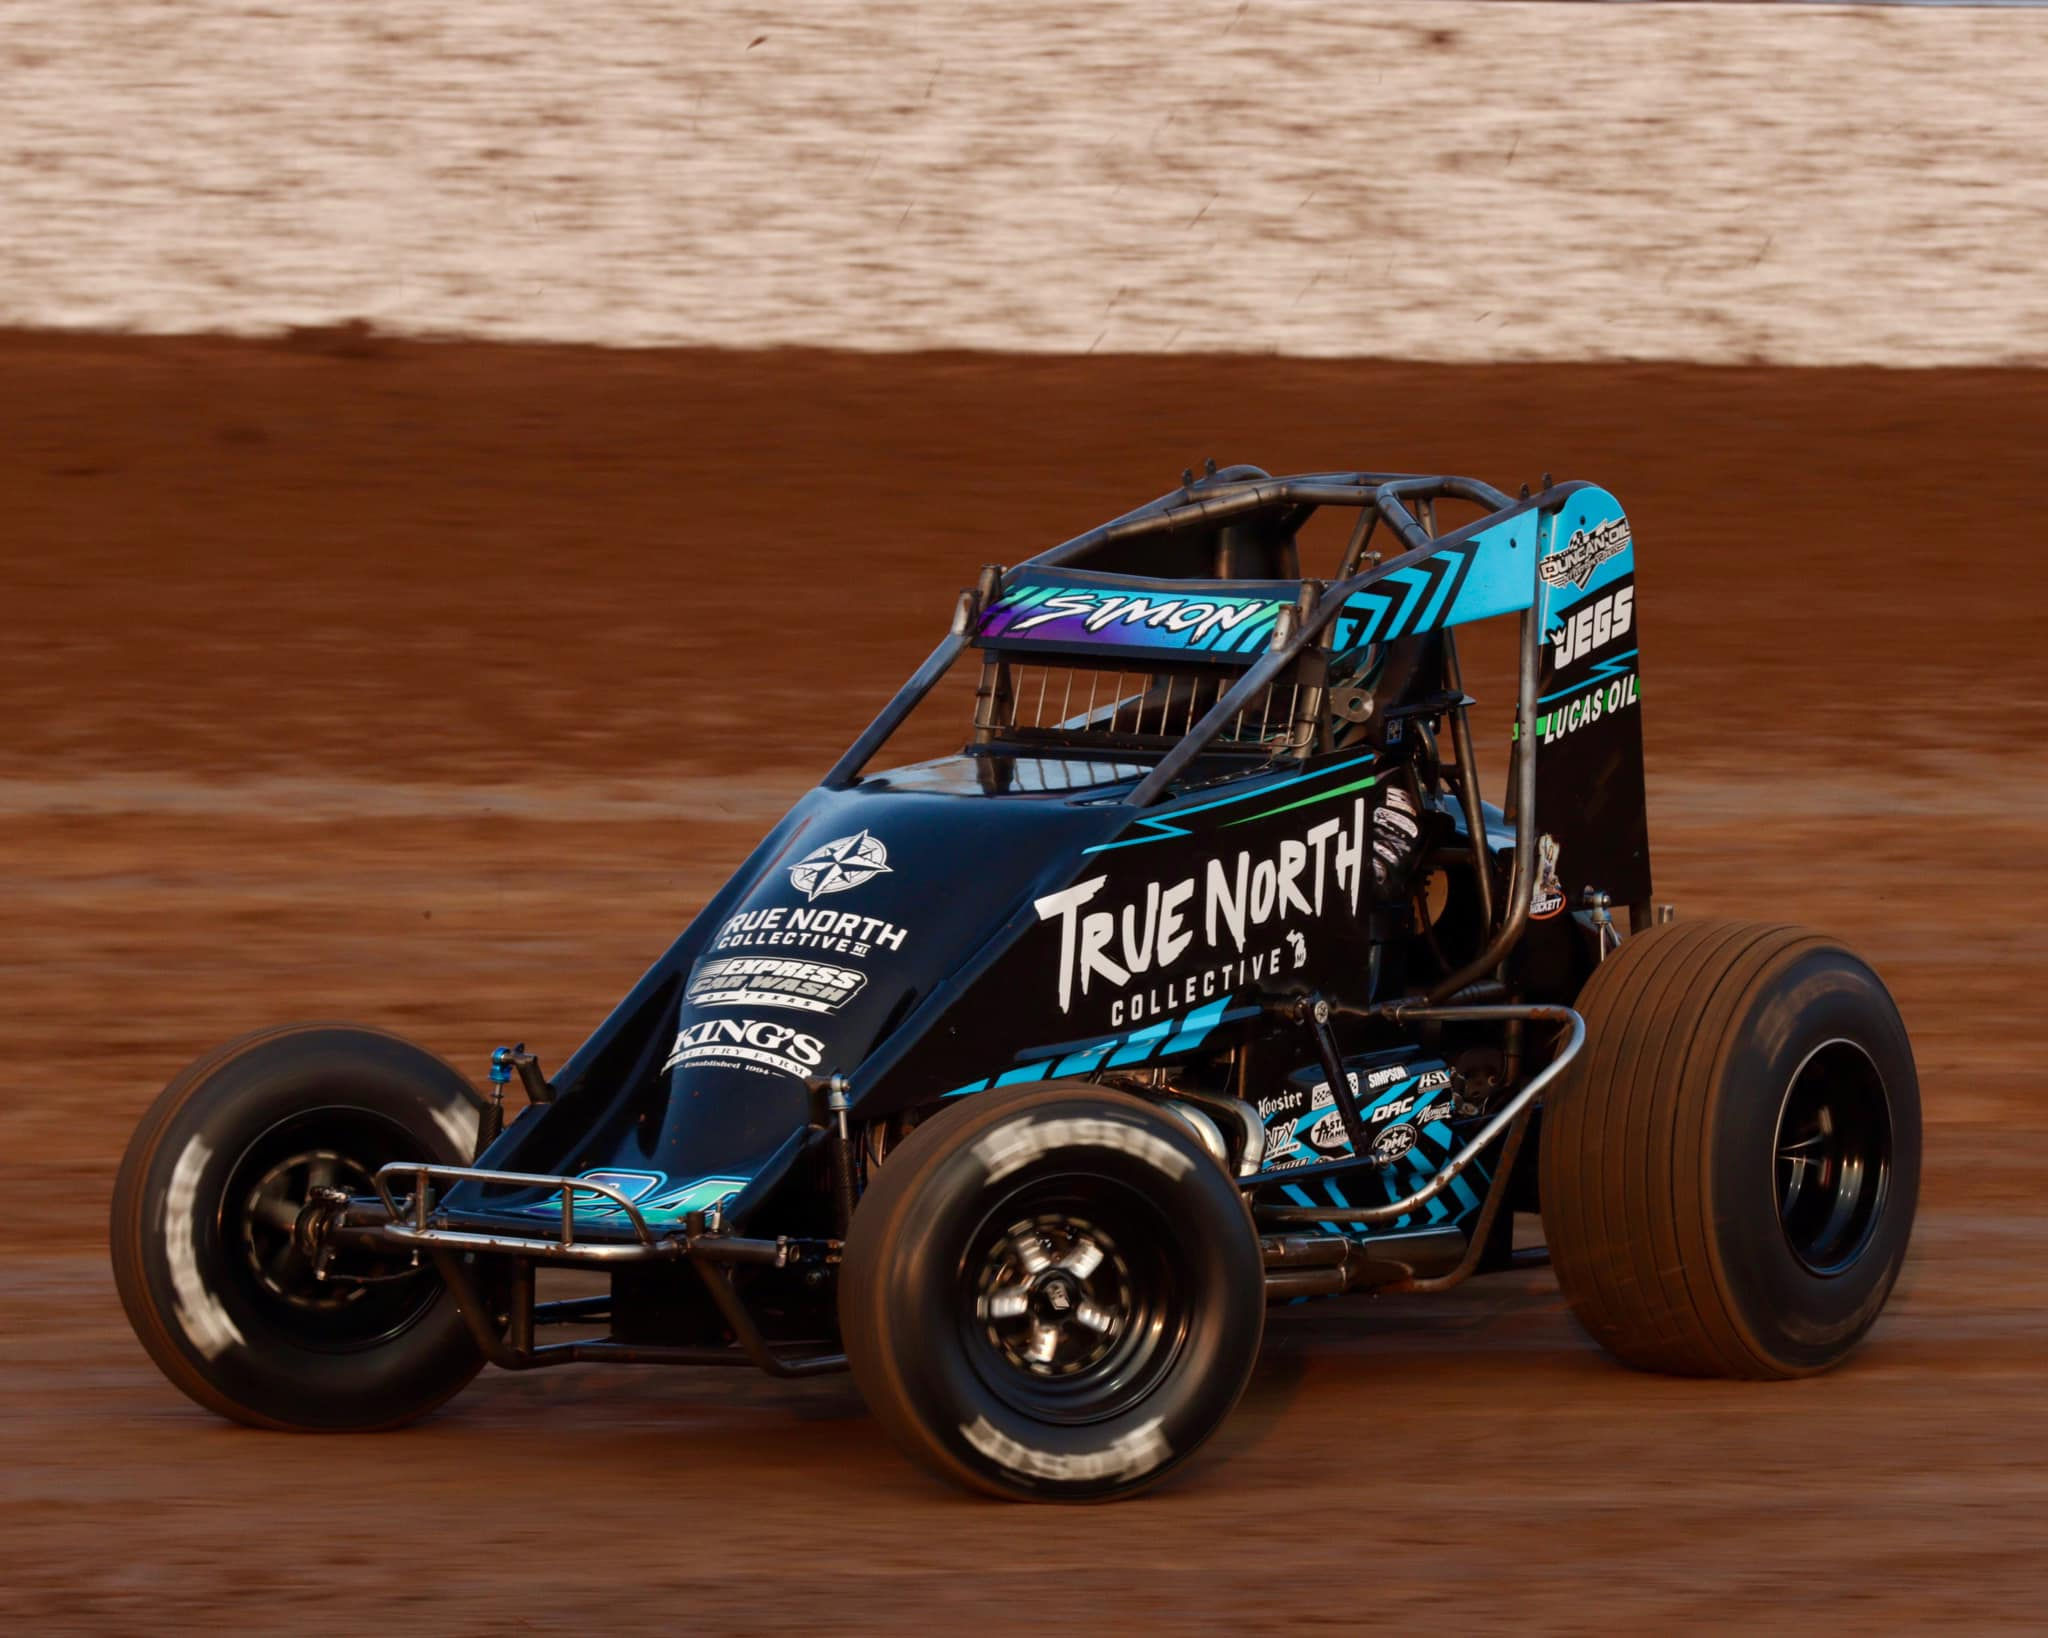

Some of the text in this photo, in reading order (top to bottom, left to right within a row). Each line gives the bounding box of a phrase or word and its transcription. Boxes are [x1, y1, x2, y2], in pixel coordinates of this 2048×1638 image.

[1540, 532, 1605, 579] DUNCAN
[1608, 524, 1632, 543] OIL
[1010, 594, 1263, 645] SIMON
[1553, 584, 1634, 670] JEGS
[1544, 673, 1637, 745] LUCAS OIL
[1033, 874, 1196, 1016] TRUE
[1205, 798, 1365, 953] NORTH
[717, 931, 851, 953] COLLECTIVE
[718, 907, 908, 951] RUE NORTH
[691, 975, 848, 1001] CAR WASH
[722, 958, 862, 989] EXPRESS
[1111, 946, 1282, 1027] COLLECTIVE
[707, 993, 811, 1006] OF TEXAS
[668, 1019, 826, 1065] KING'S
[684, 1060, 741, 1069] Established
[753, 1052, 805, 1075] FARM
[1368, 1066, 1407, 1089] SIMPSON
[1257, 1090, 1303, 1119] Hoosier
[1371, 1096, 1415, 1123] DRC
[1265, 1118, 1298, 1151] NDY
